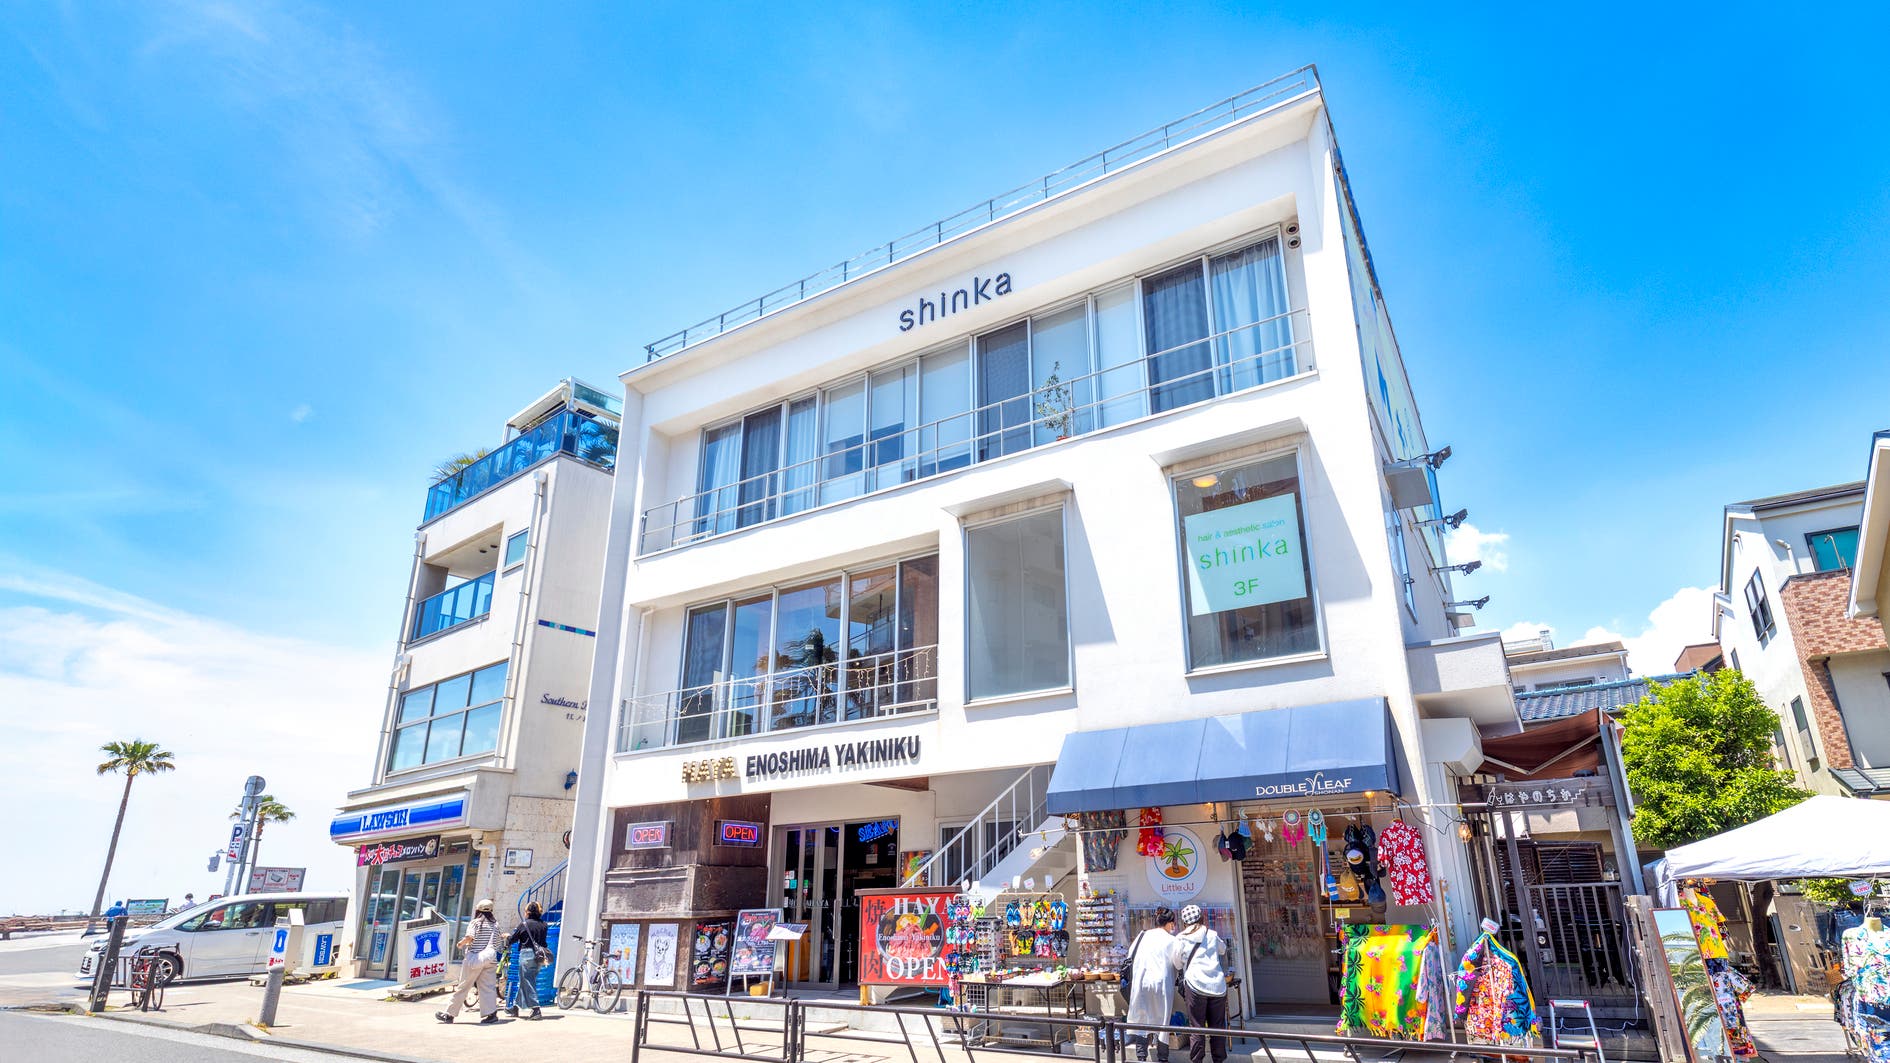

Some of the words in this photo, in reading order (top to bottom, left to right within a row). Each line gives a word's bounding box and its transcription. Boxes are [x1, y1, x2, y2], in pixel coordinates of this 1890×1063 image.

[899, 272, 1012, 331] shinka
[1198, 533, 1212, 542] hair
[1262, 519, 1285, 529] salon
[1200, 538, 1288, 569] shinka
[1234, 578, 1259, 596] 3F
[541, 693, 579, 709] Southern
[566, 713, 586, 722] 江ノ
[682, 756, 739, 783] HAYA
[746, 746, 830, 777] ENOSHIMA
[835, 735, 920, 766] YAKINIKU
[1256, 783, 1307, 796] DOUBLE
[1317, 778, 1352, 790] LEAF
[362, 809, 409, 831] LAWSON
[232, 827, 243, 841] P
[634, 828, 662, 842] OPEN
[725, 825, 756, 841] OPEN
[1162, 883, 1182, 892] Little
[894, 896, 953, 915] HAYA
[318, 935, 328, 965] LAWSON
[886, 956, 951, 980] OPEN
